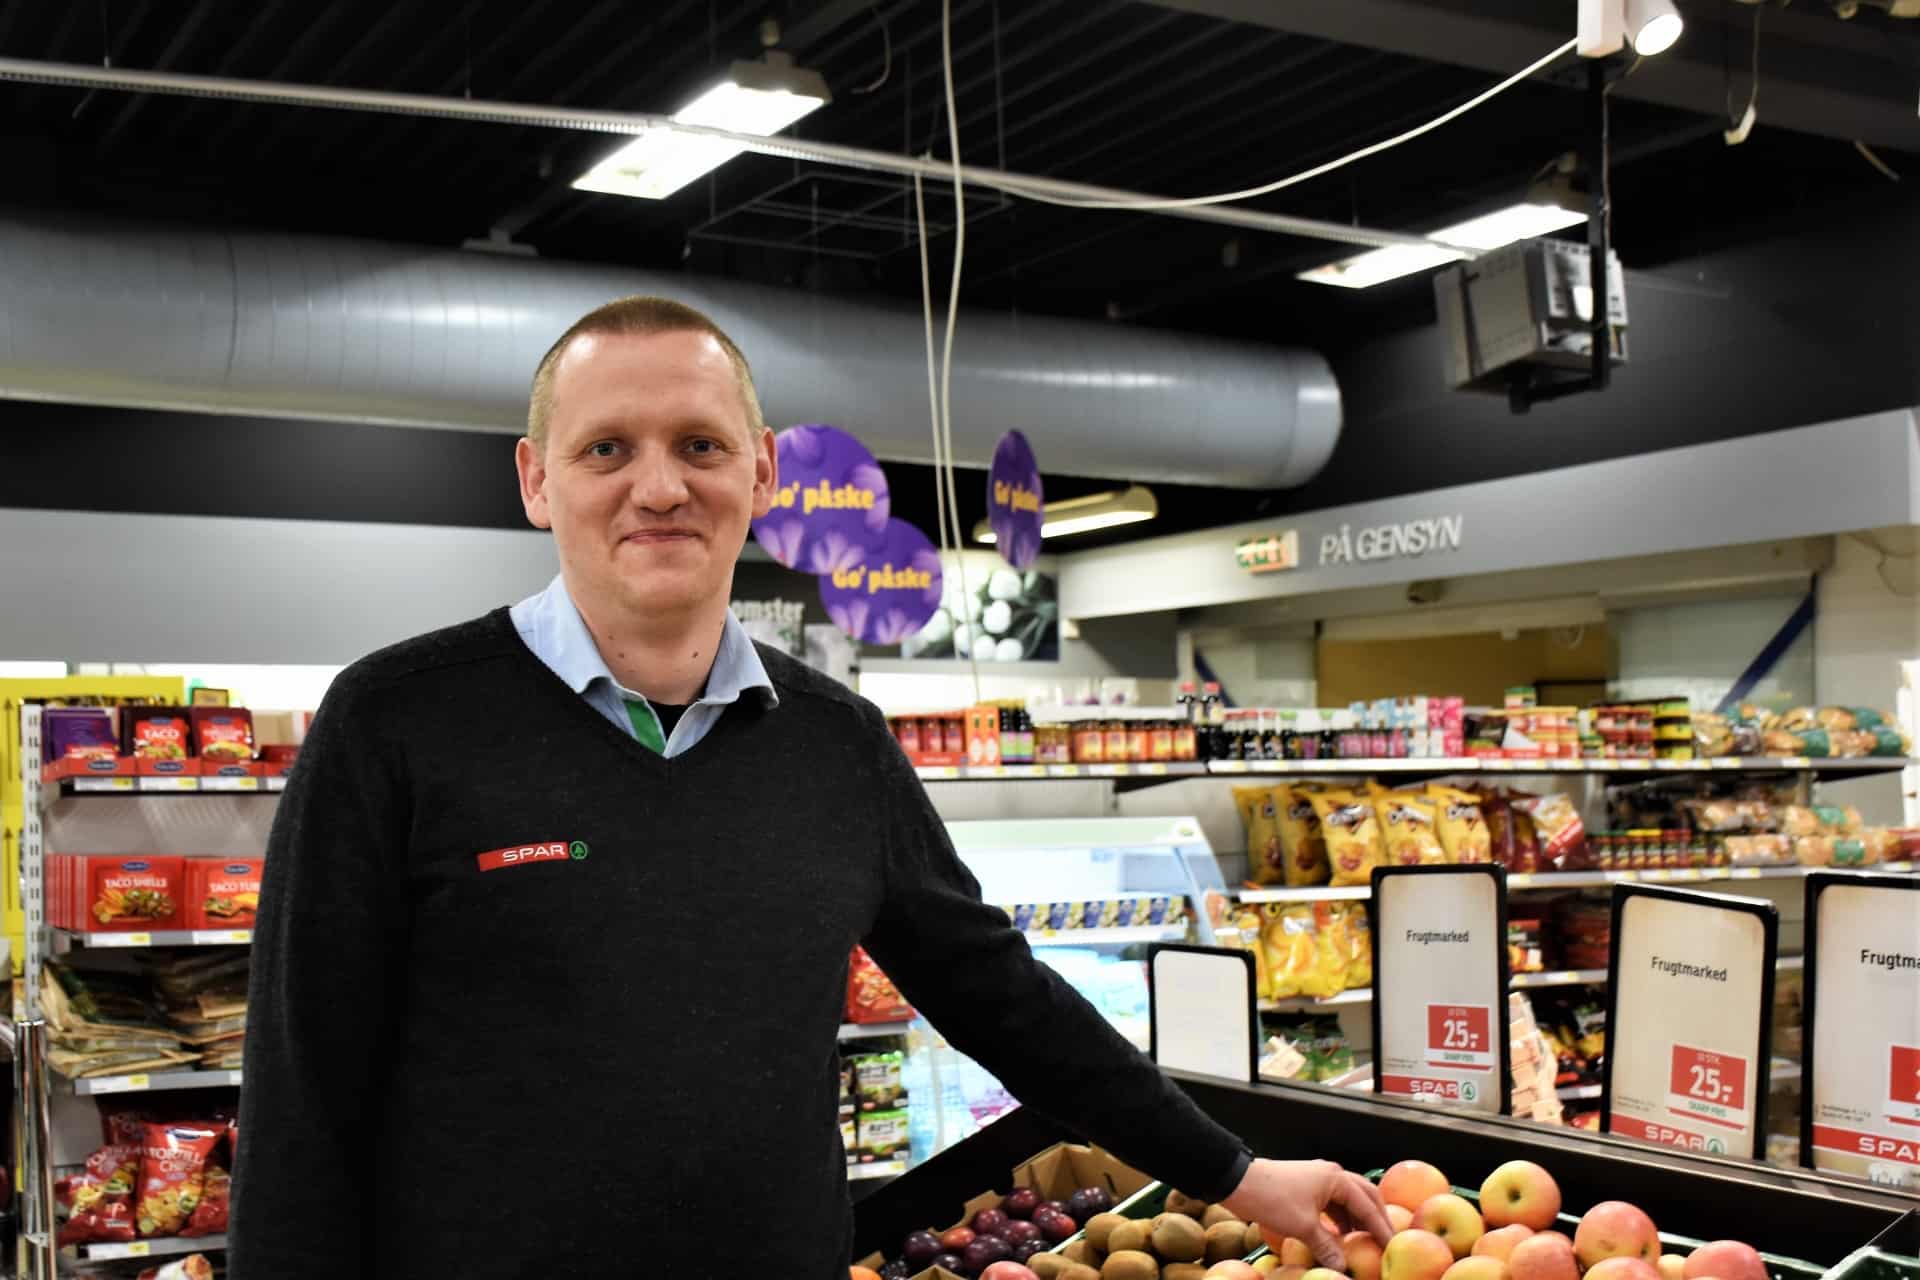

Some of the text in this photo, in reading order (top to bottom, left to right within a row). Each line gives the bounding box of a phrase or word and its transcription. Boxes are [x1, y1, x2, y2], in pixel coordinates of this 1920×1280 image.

[803, 479, 875, 515] påske
[1319, 524, 1352, 565] PÅ
[1356, 515, 1463, 560] GENSYN
[868, 563, 931, 594] påske
[731, 598, 804, 624] omster
[502, 844, 565, 863] SPAR
[105, 877, 131, 889] TACO
[1406, 930, 1470, 945] Frugtmarked
[1651, 956, 1727, 981] Frugtmarked
[1409, 1080, 1458, 1096] SPAR
[1645, 1125, 1704, 1151] SPAR
[1859, 1136, 1920, 1161] SPA
